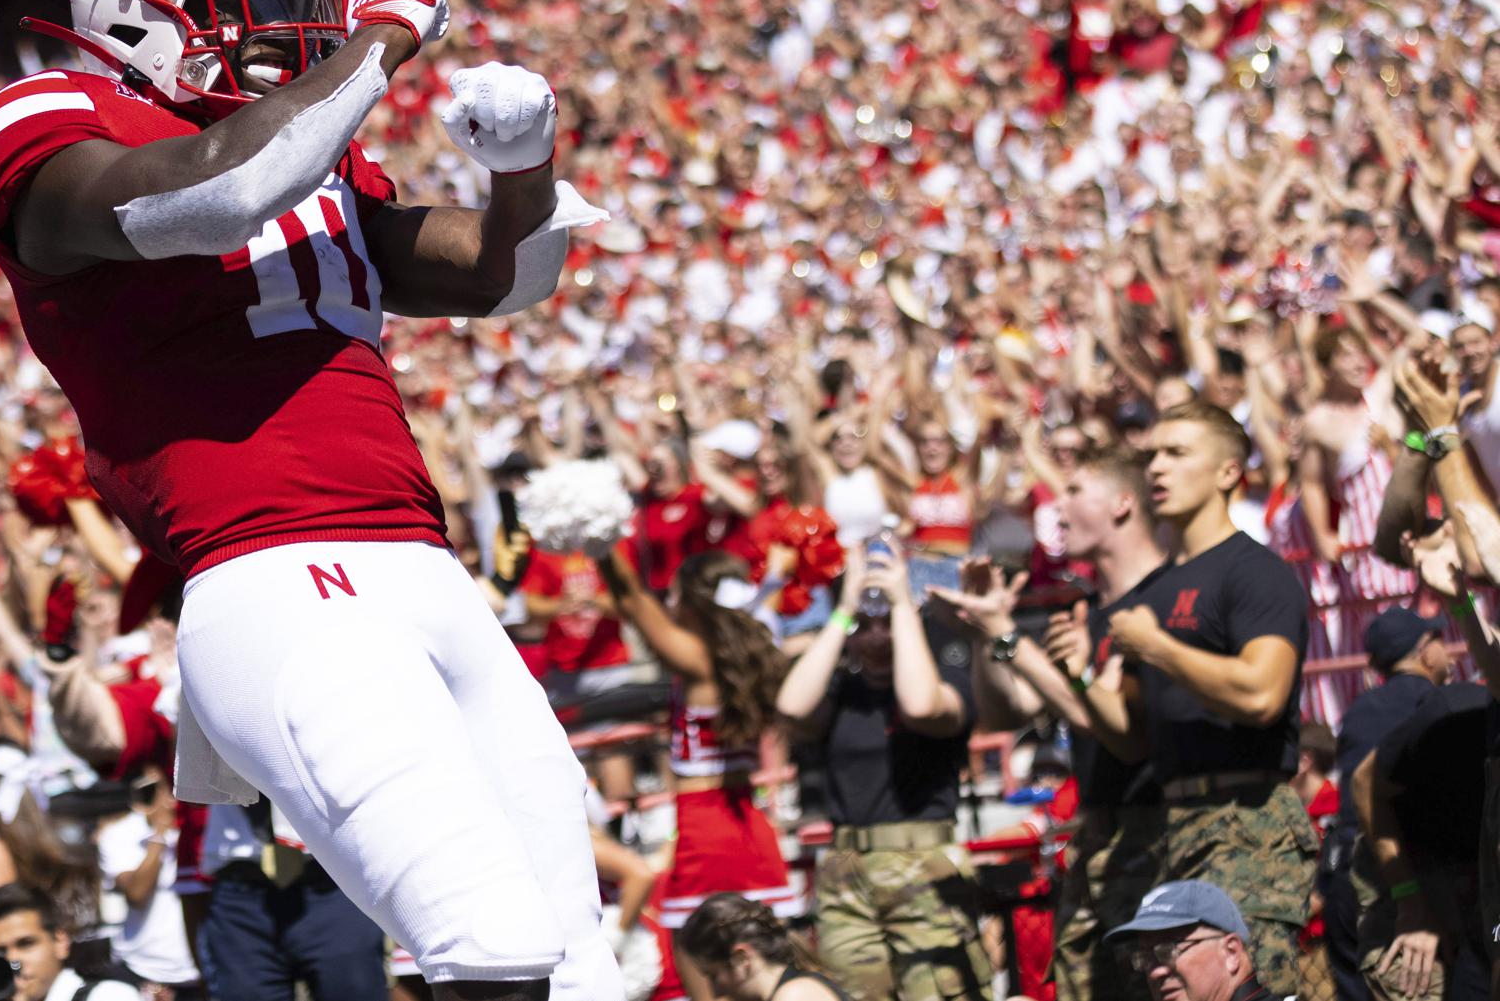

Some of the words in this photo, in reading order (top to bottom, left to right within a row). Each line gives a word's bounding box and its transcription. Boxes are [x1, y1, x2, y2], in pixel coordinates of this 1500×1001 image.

[221, 25, 240, 43] N
[245, 171, 384, 349] 10
[306, 562, 358, 600] N
